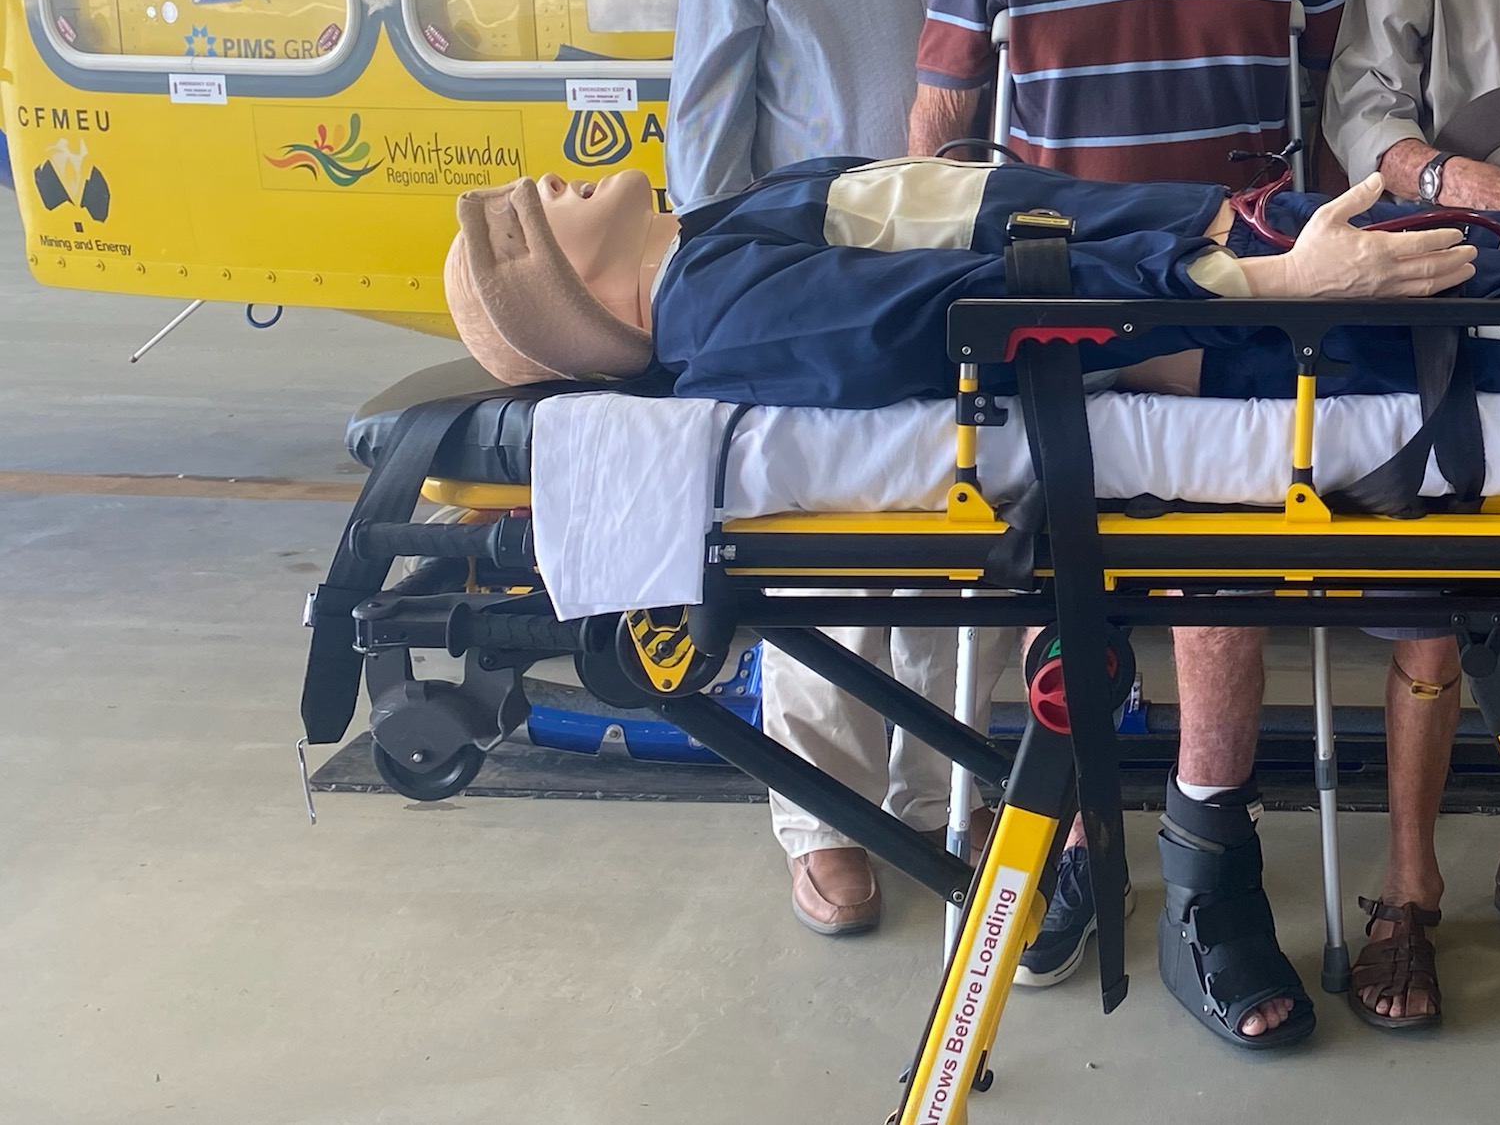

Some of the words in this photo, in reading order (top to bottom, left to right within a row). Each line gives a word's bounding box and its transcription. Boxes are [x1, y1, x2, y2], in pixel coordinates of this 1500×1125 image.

[223, 38, 276, 59] PIMS
[17, 106, 111, 132] CFMEU
[384, 132, 522, 178] Whitsunday
[387, 168, 438, 187] Regional
[444, 169, 491, 186] Council
[40, 235, 73, 252] Mining
[74, 240, 94, 251] and
[95, 240, 133, 256] Energy
[945, 981, 982, 1054] Before
[971, 887, 1017, 977] Loading
